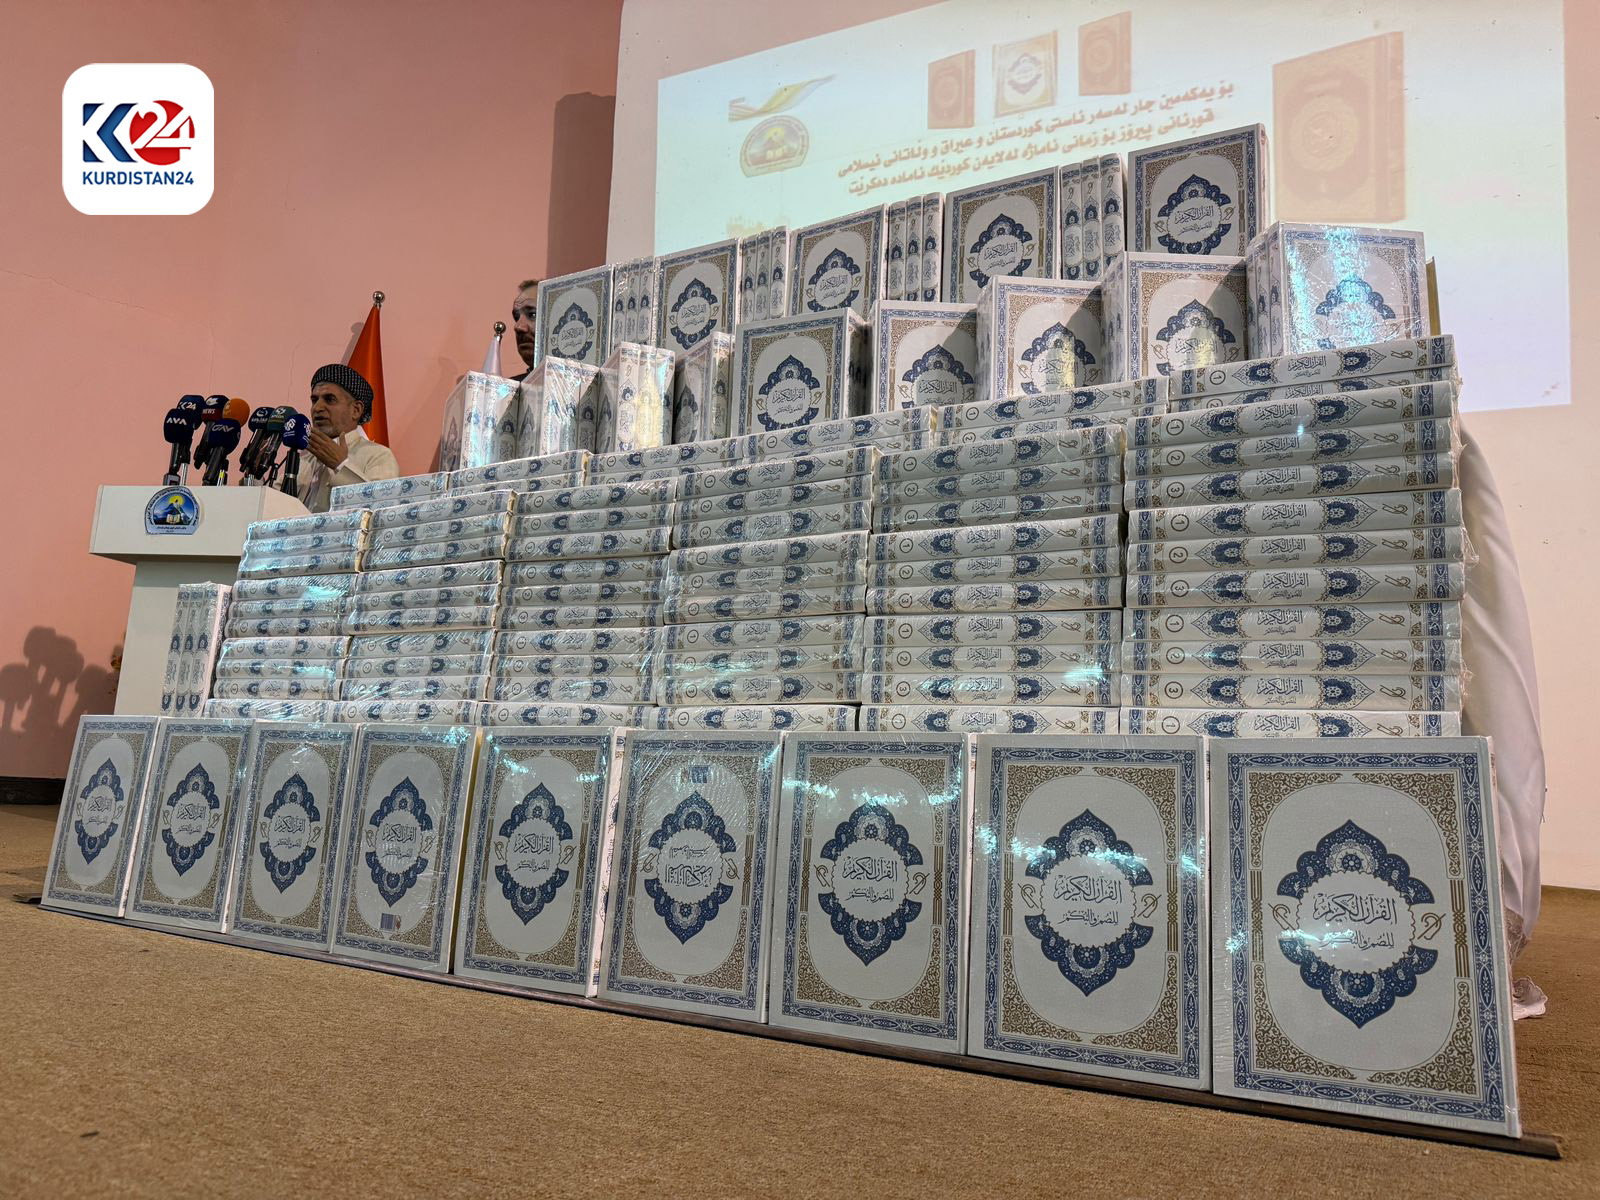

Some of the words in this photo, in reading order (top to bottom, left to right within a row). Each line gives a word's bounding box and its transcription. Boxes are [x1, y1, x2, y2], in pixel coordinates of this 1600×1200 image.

[1133, 100, 1155, 115] جار
[1053, 874, 1093, 902] الكريم
[1083, 876, 1122, 904] القرآن
[1313, 893, 1364, 922] الكريم
[1349, 893, 1397, 925] القرآن
